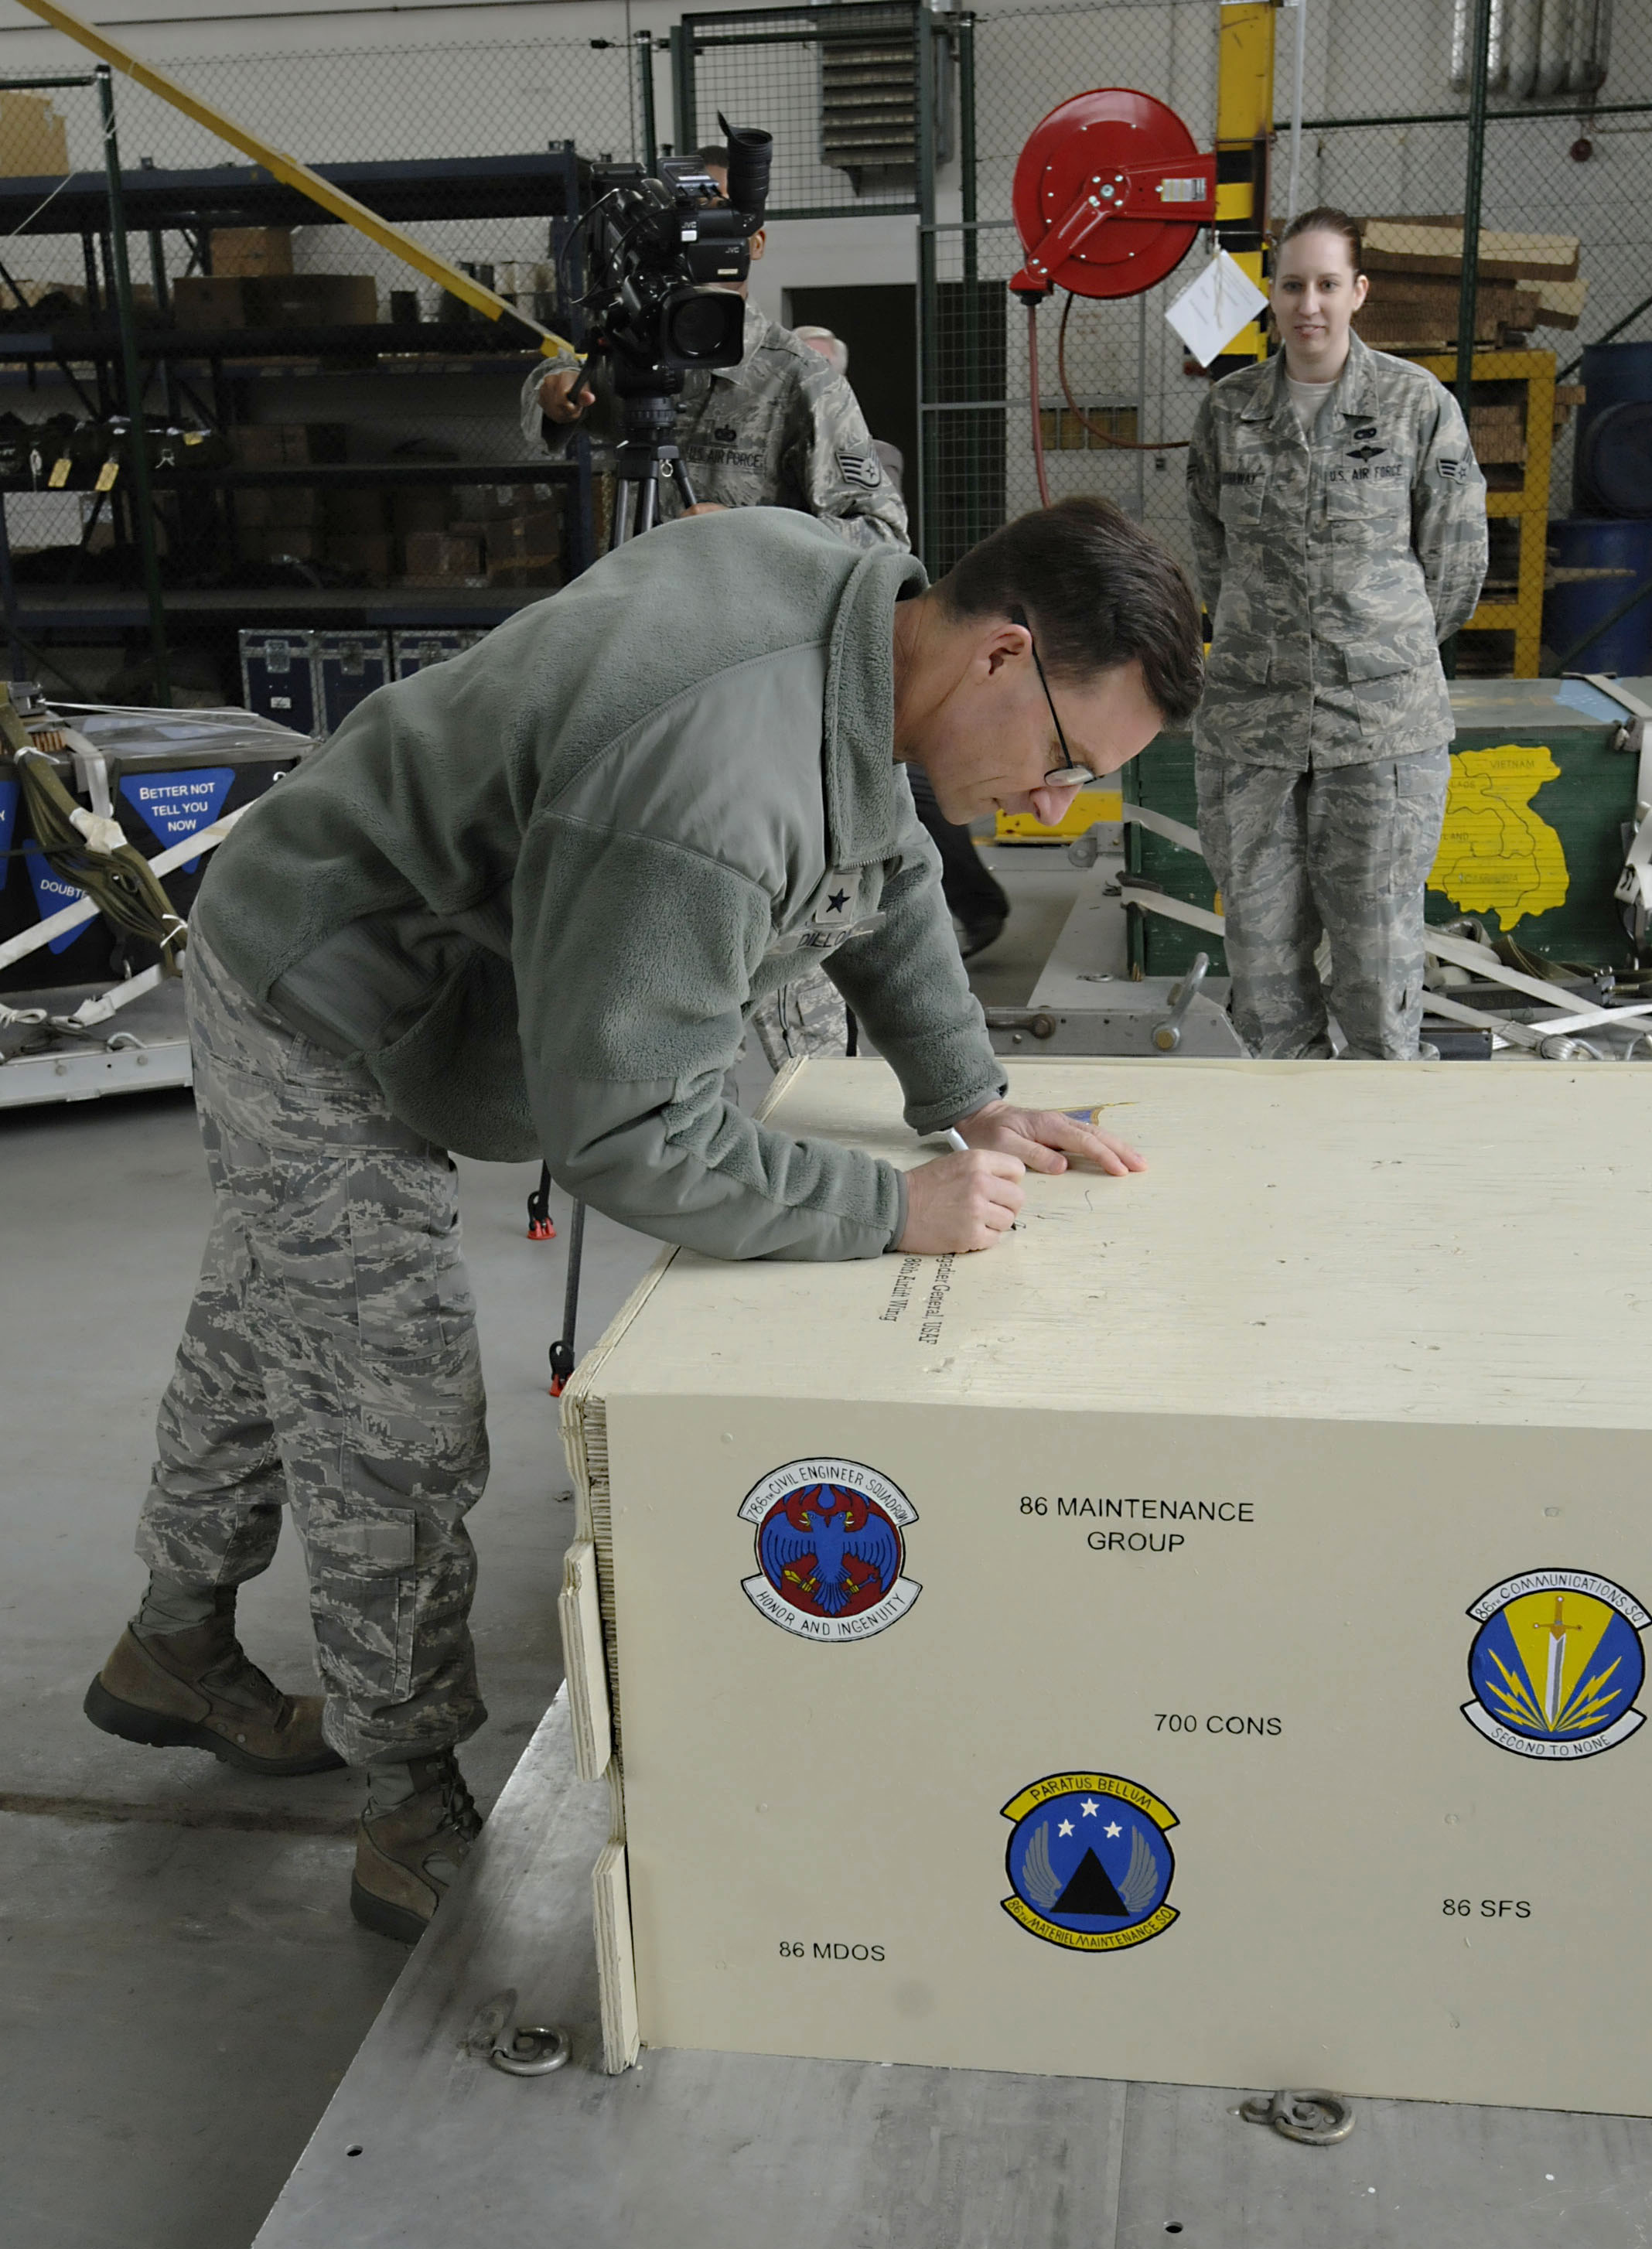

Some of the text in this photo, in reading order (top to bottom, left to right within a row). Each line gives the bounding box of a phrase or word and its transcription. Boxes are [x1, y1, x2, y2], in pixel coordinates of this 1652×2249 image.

[726, 451, 764, 469] FORCE
[1352, 467, 1370, 479] AIR
[1374, 464, 1403, 478] FORCE
[1490, 759, 1536, 769] VIETNAM
[139, 782, 216, 800] BETTER NOT
[151, 800, 209, 817] TELL YOU
[167, 818, 197, 832] NOW
[796, 929, 852, 948] DILLO
[878, 1258, 922, 1322] 86th Airlift Wing
[921, 1285, 951, 1319] General,
[918, 1321, 942, 1345] USAF
[773, 1473, 799, 1495] CIVIL
[798, 1465, 865, 1486] ENGINEER
[865, 1479, 909, 1524] SQUADRON
[1019, 1496, 1254, 1522] 86 MAINTENANCE
[1087, 1531, 1185, 1552] GROUP
[1500, 1573, 1623, 1608] COMMUNICATIONS
[1624, 1602, 1645, 1623] SQ
[756, 1590, 906, 1636] HONOR AND INGENUITY
[1154, 1714, 1282, 1735] 700 CONS
[1490, 1727, 1611, 1756] SECOND TO NONE
[1029, 1777, 1152, 1810] PARATUS BELLUM
[1442, 1899, 1531, 1919] 86 SFS
[1026, 1918, 1080, 1946] MATERIEL
[1076, 1922, 1159, 1947] MAINTENANCE
[1155, 1909, 1173, 1926] SQ
[779, 1941, 886, 1961] 86 MDOS
